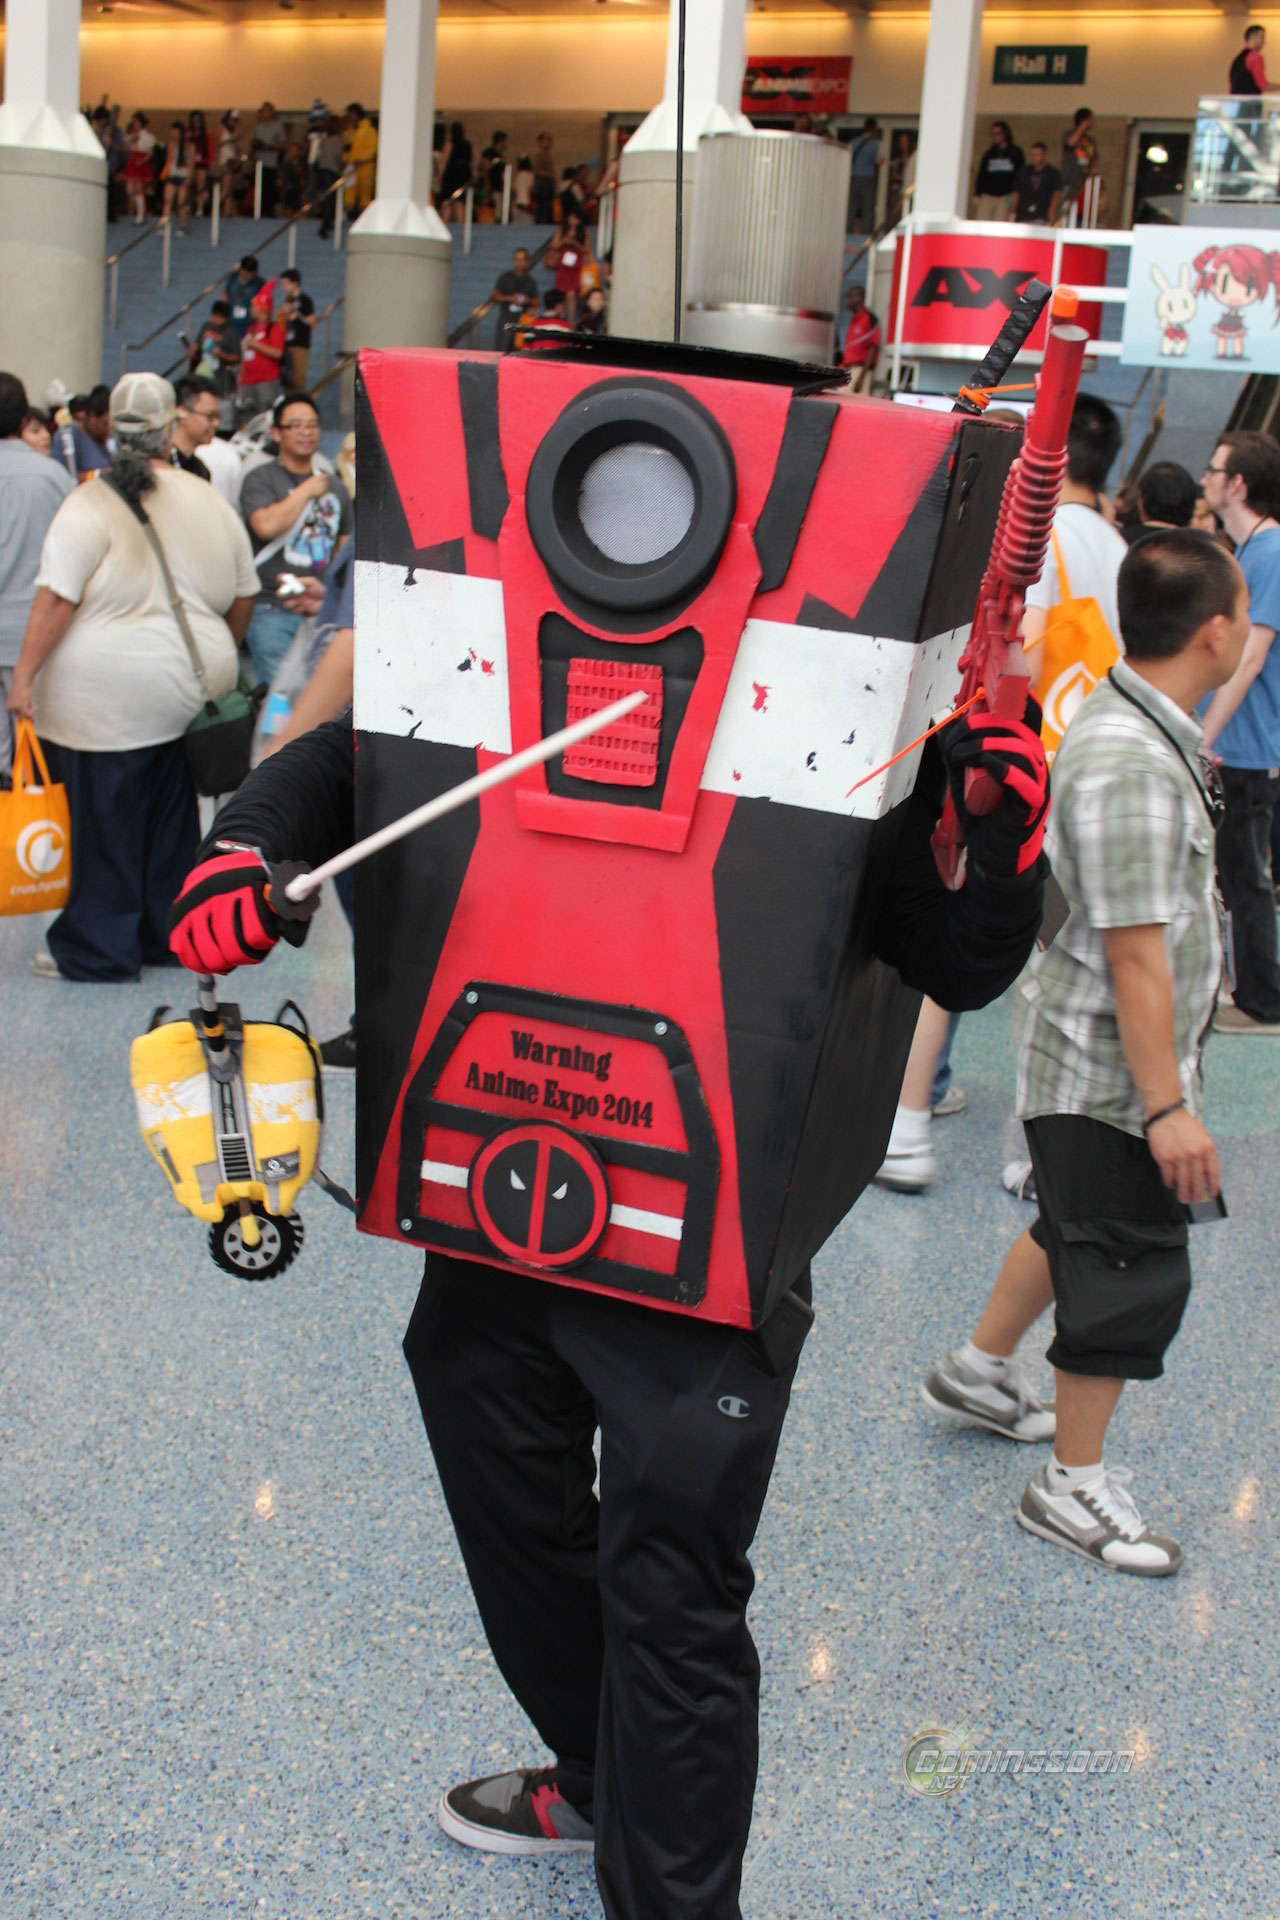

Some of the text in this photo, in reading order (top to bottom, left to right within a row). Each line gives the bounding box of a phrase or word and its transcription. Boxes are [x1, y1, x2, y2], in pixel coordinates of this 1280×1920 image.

[1013, 54, 1067, 74] Hall H
[911, 266, 1039, 312] AX
[511, 1030, 612, 1081] Warning
[465, 1062, 654, 1128] Anime Expo 2014
